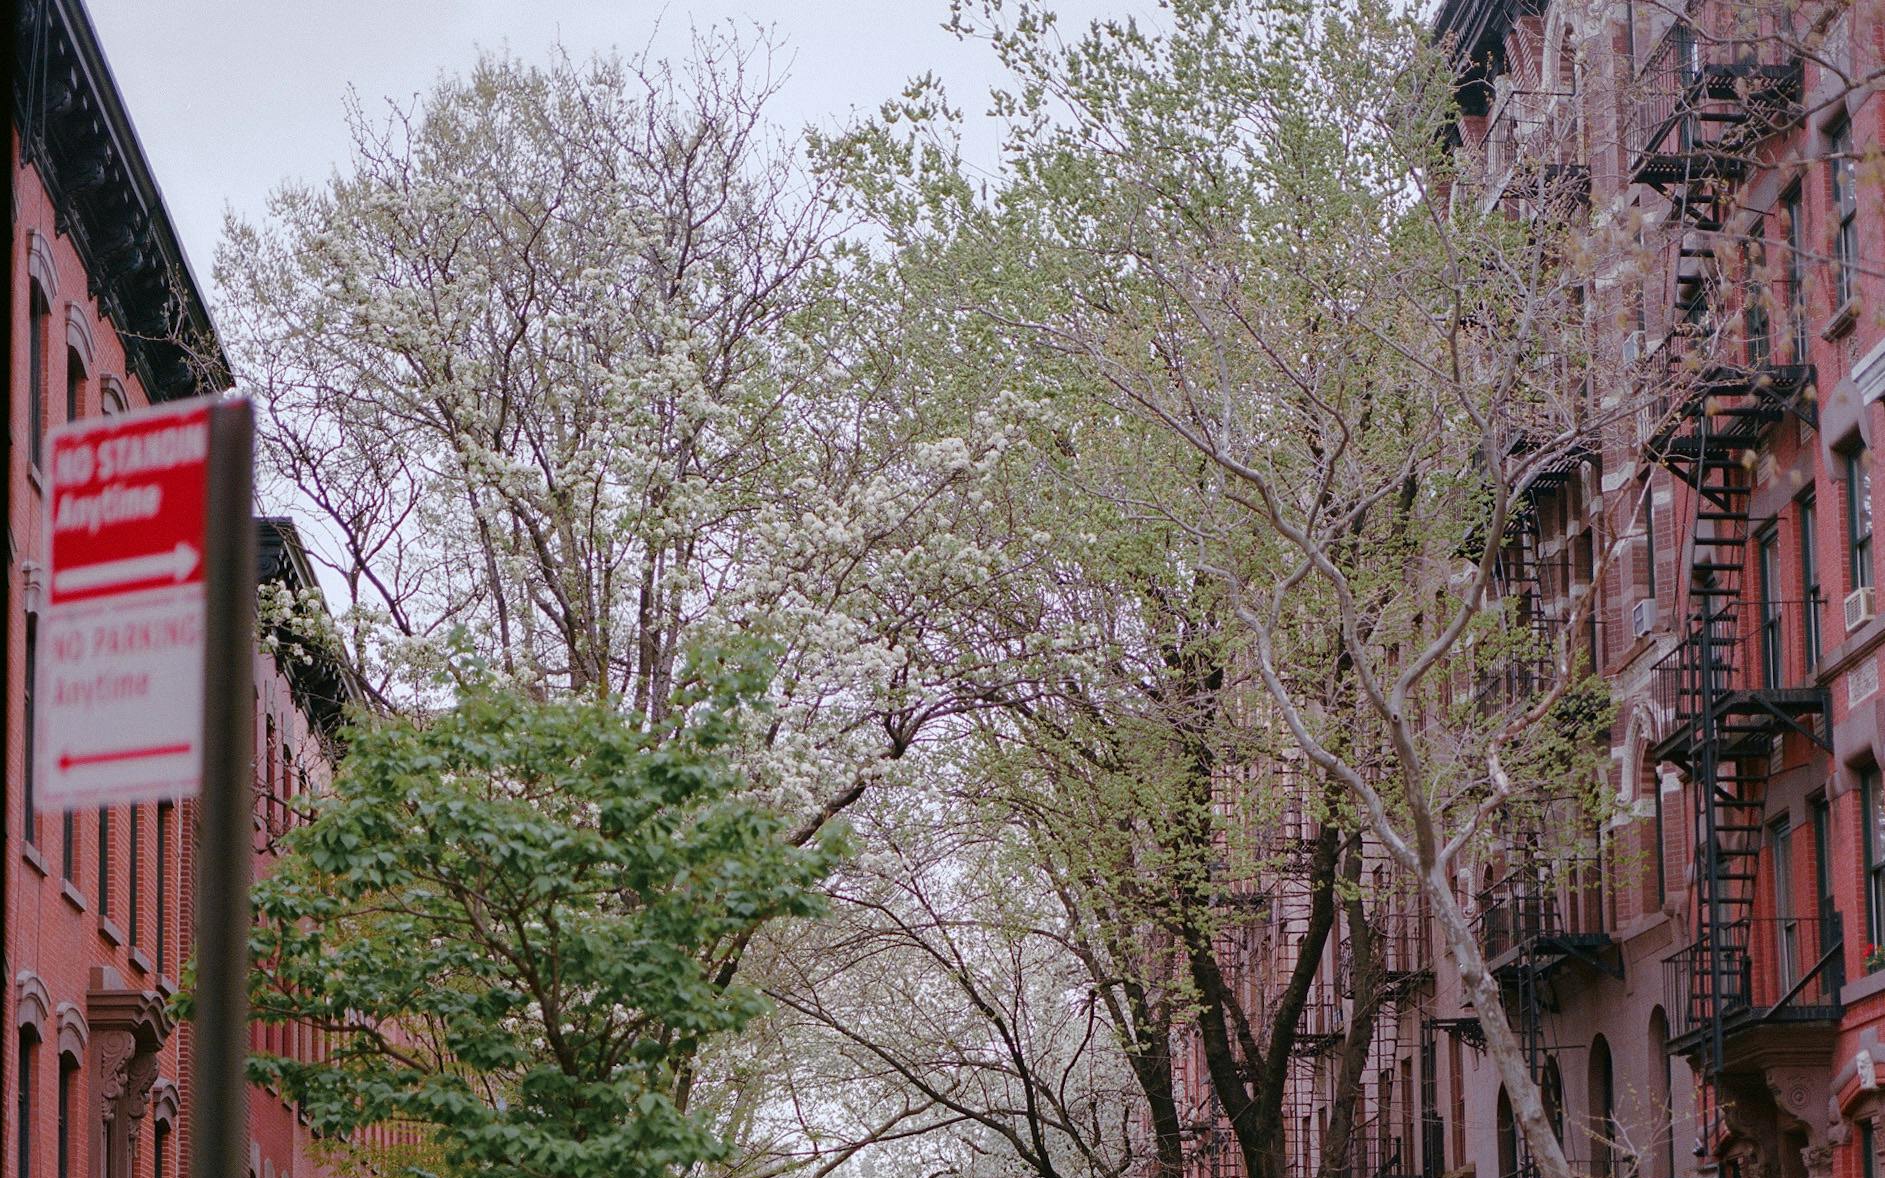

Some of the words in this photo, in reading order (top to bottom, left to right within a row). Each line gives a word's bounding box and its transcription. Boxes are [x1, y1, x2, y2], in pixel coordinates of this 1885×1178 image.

[56, 445, 93, 485] NO
[97, 423, 207, 480] STANDIN
[54, 485, 161, 532] Anytime
[54, 631, 84, 664] NO
[93, 613, 197, 655] PARKING
